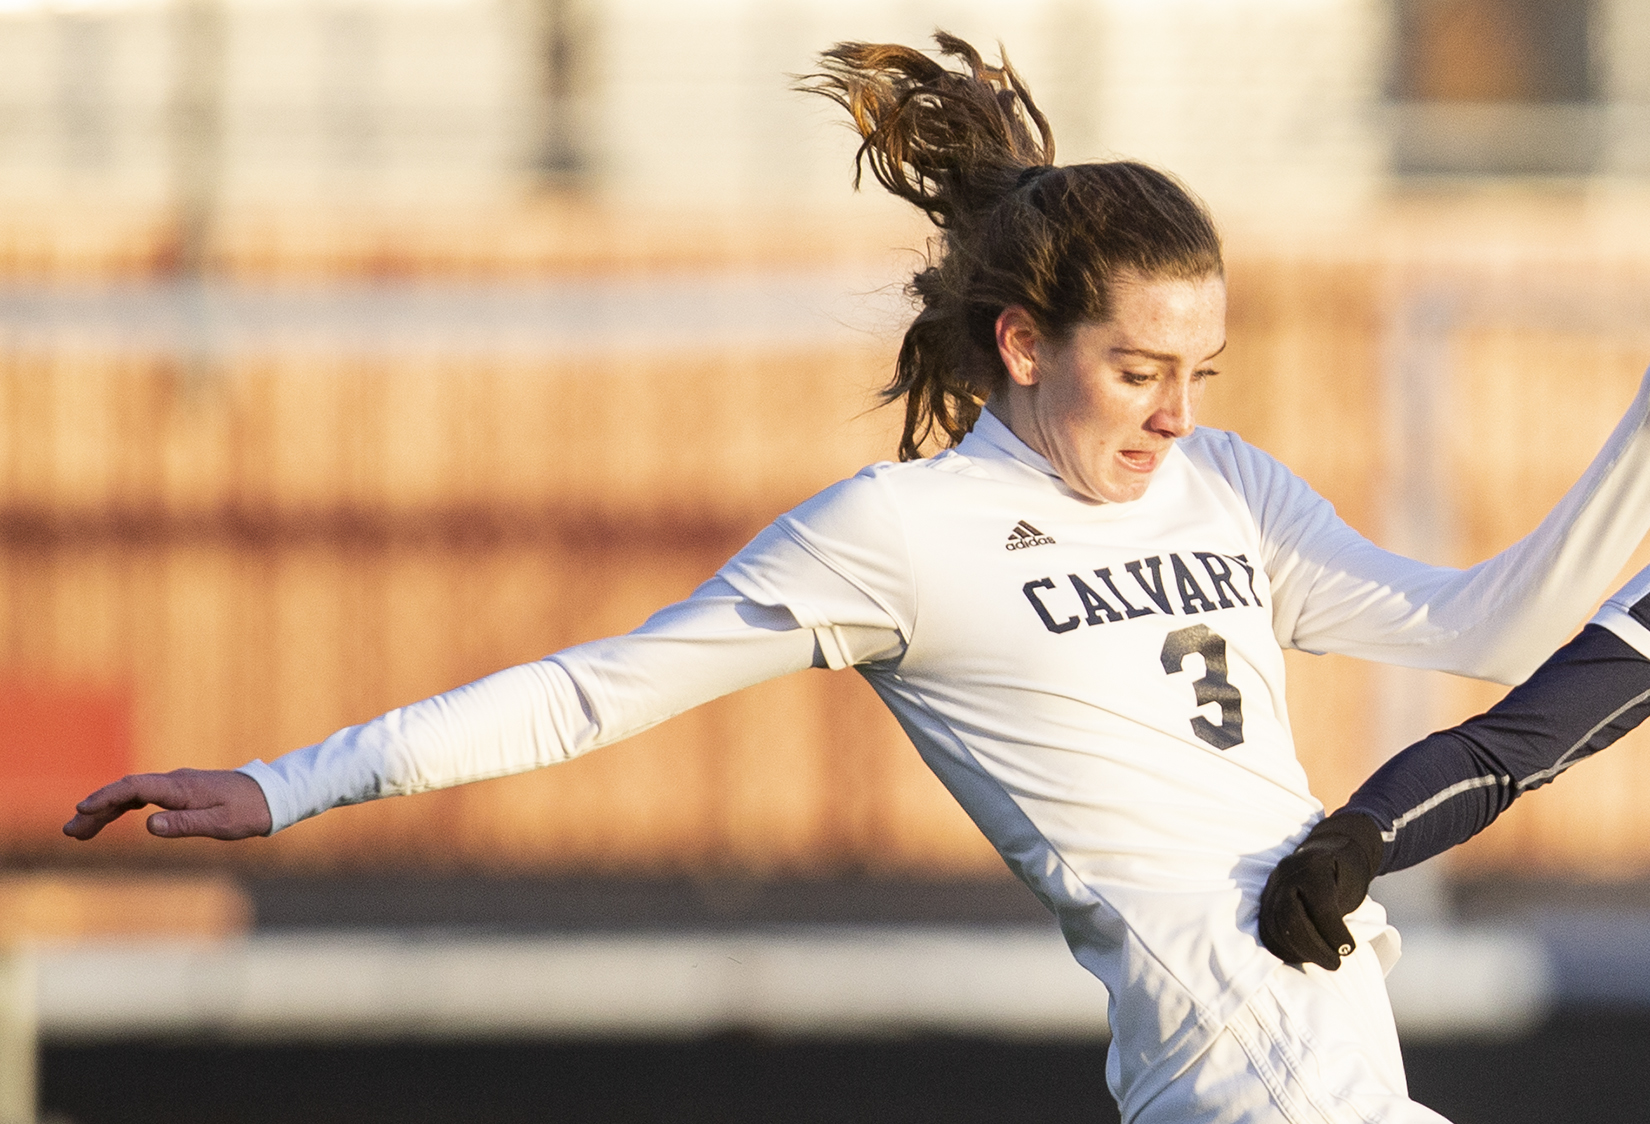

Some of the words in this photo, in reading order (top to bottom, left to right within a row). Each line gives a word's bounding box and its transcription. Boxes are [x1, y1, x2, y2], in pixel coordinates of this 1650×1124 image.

[1005, 536, 1056, 551] adidas
[1023, 551, 1264, 634] CALVARY
[1160, 623, 1244, 751] 3
